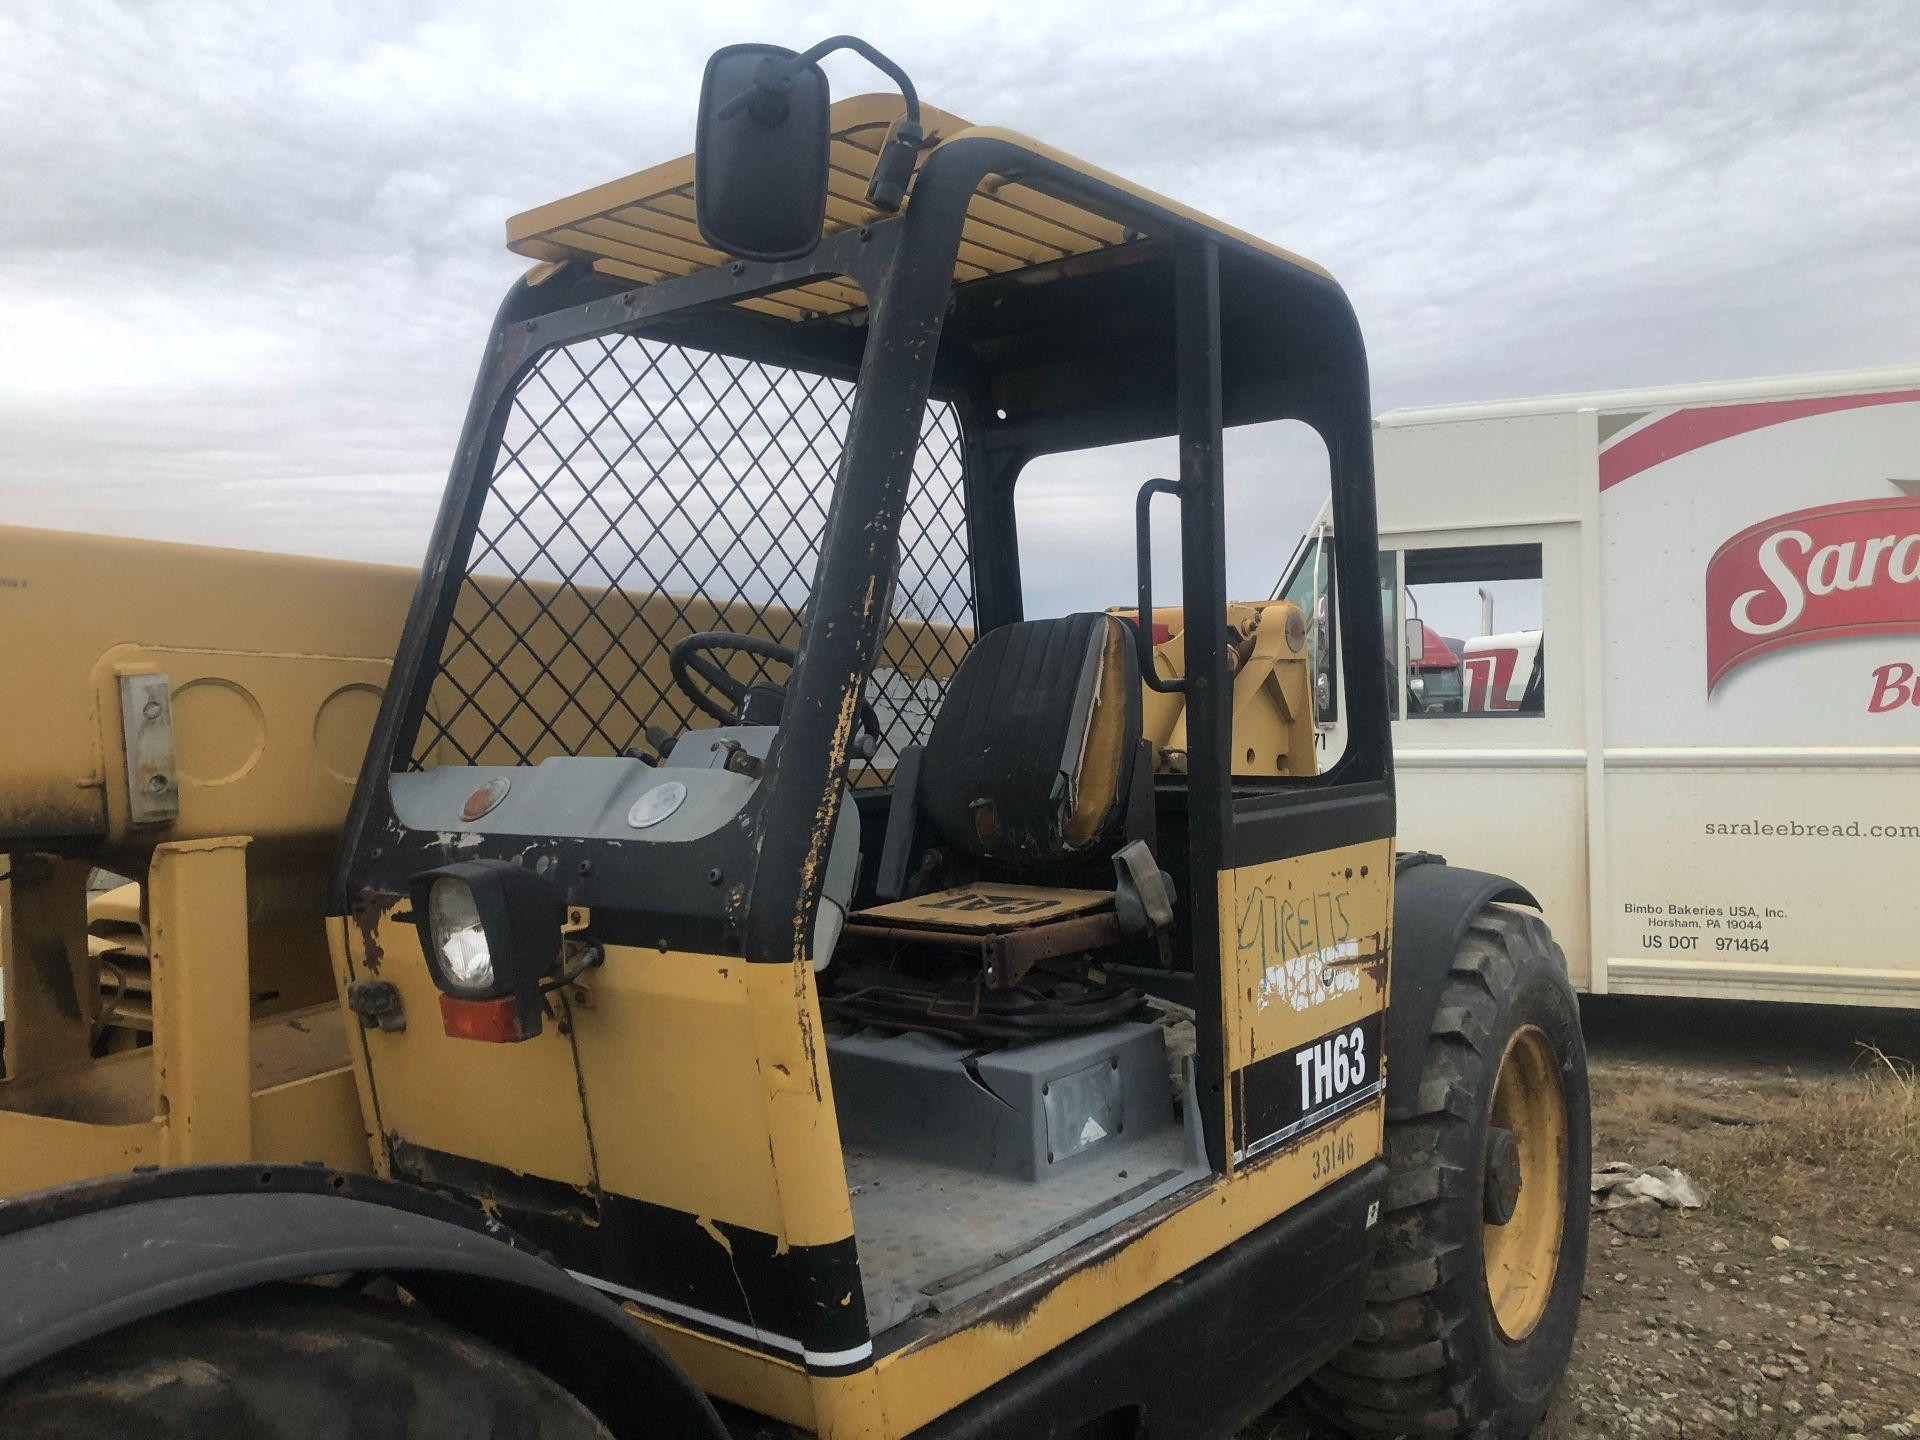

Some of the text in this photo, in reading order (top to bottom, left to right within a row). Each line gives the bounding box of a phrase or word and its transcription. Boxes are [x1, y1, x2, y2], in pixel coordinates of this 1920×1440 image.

[1704, 820, 1920, 838] saraleebread.com
[1624, 903, 1788, 919] Bimbo Bakeries USA, Inc.
[1648, 918, 1763, 931] Horsham, PA 19044
[1642, 934, 1770, 953] US DOT 971464
[1295, 1026, 1366, 1112] TH63
[1312, 1132, 1354, 1180] 33146
